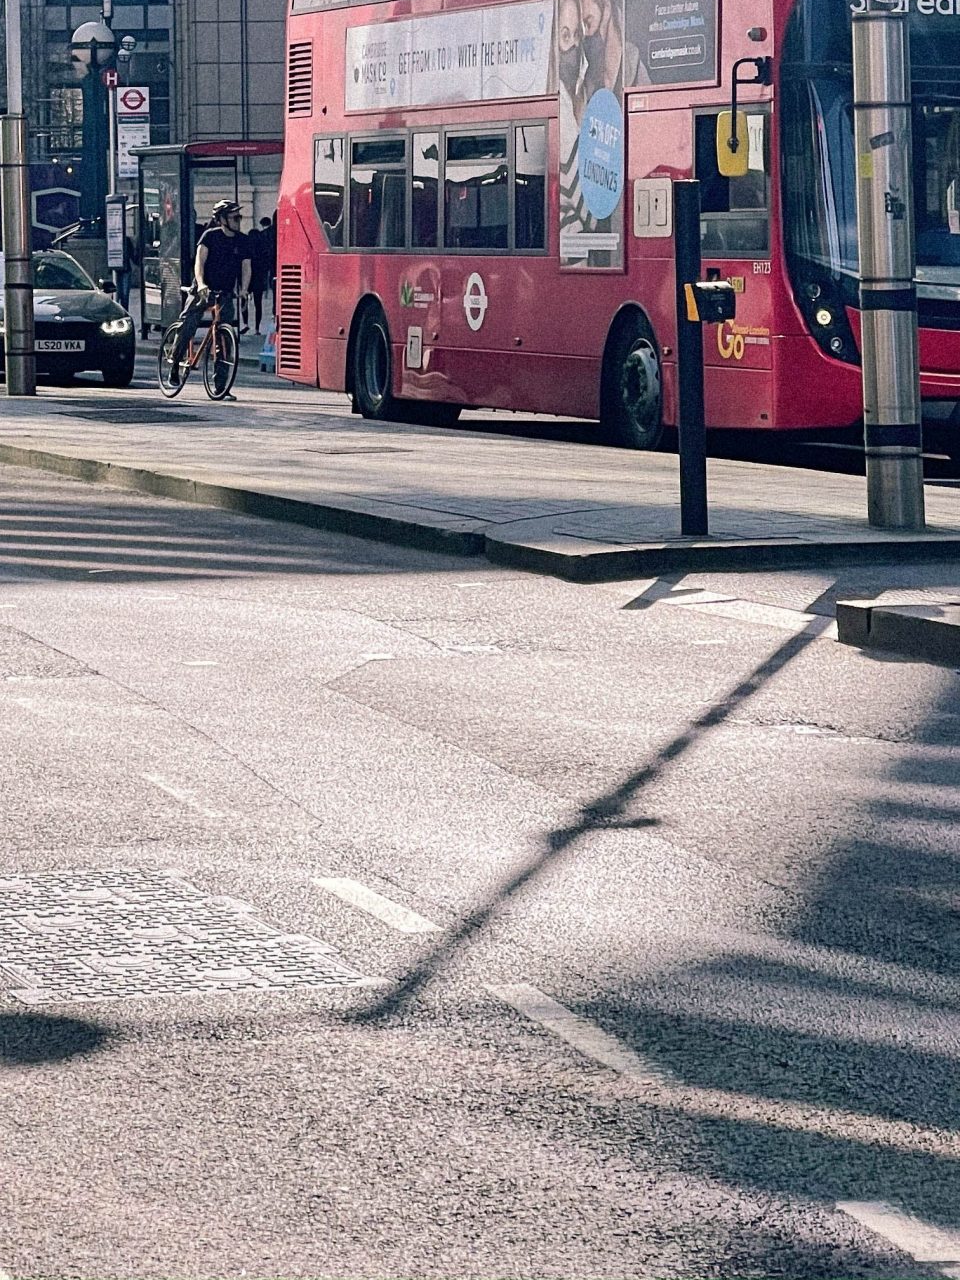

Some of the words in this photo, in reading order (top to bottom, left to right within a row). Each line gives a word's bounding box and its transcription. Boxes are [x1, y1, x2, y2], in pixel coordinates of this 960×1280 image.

[398, 51, 411, 75] GET
[411, 48, 430, 74] FROM
[437, 47, 446, 71] TO
[457, 43, 478, 69] WITH
[480, 41, 495, 66] THE
[497, 39, 519, 64] RIGHT
[106, 72, 118, 86] H
[361, 63, 377, 84] MASK
[583, 158, 618, 193] LONDON25
[753, 262, 771, 274] EH123
[37, 341, 62, 350] LS20
[64, 341, 82, 350] VKA
[717, 319, 745, 360] Go
